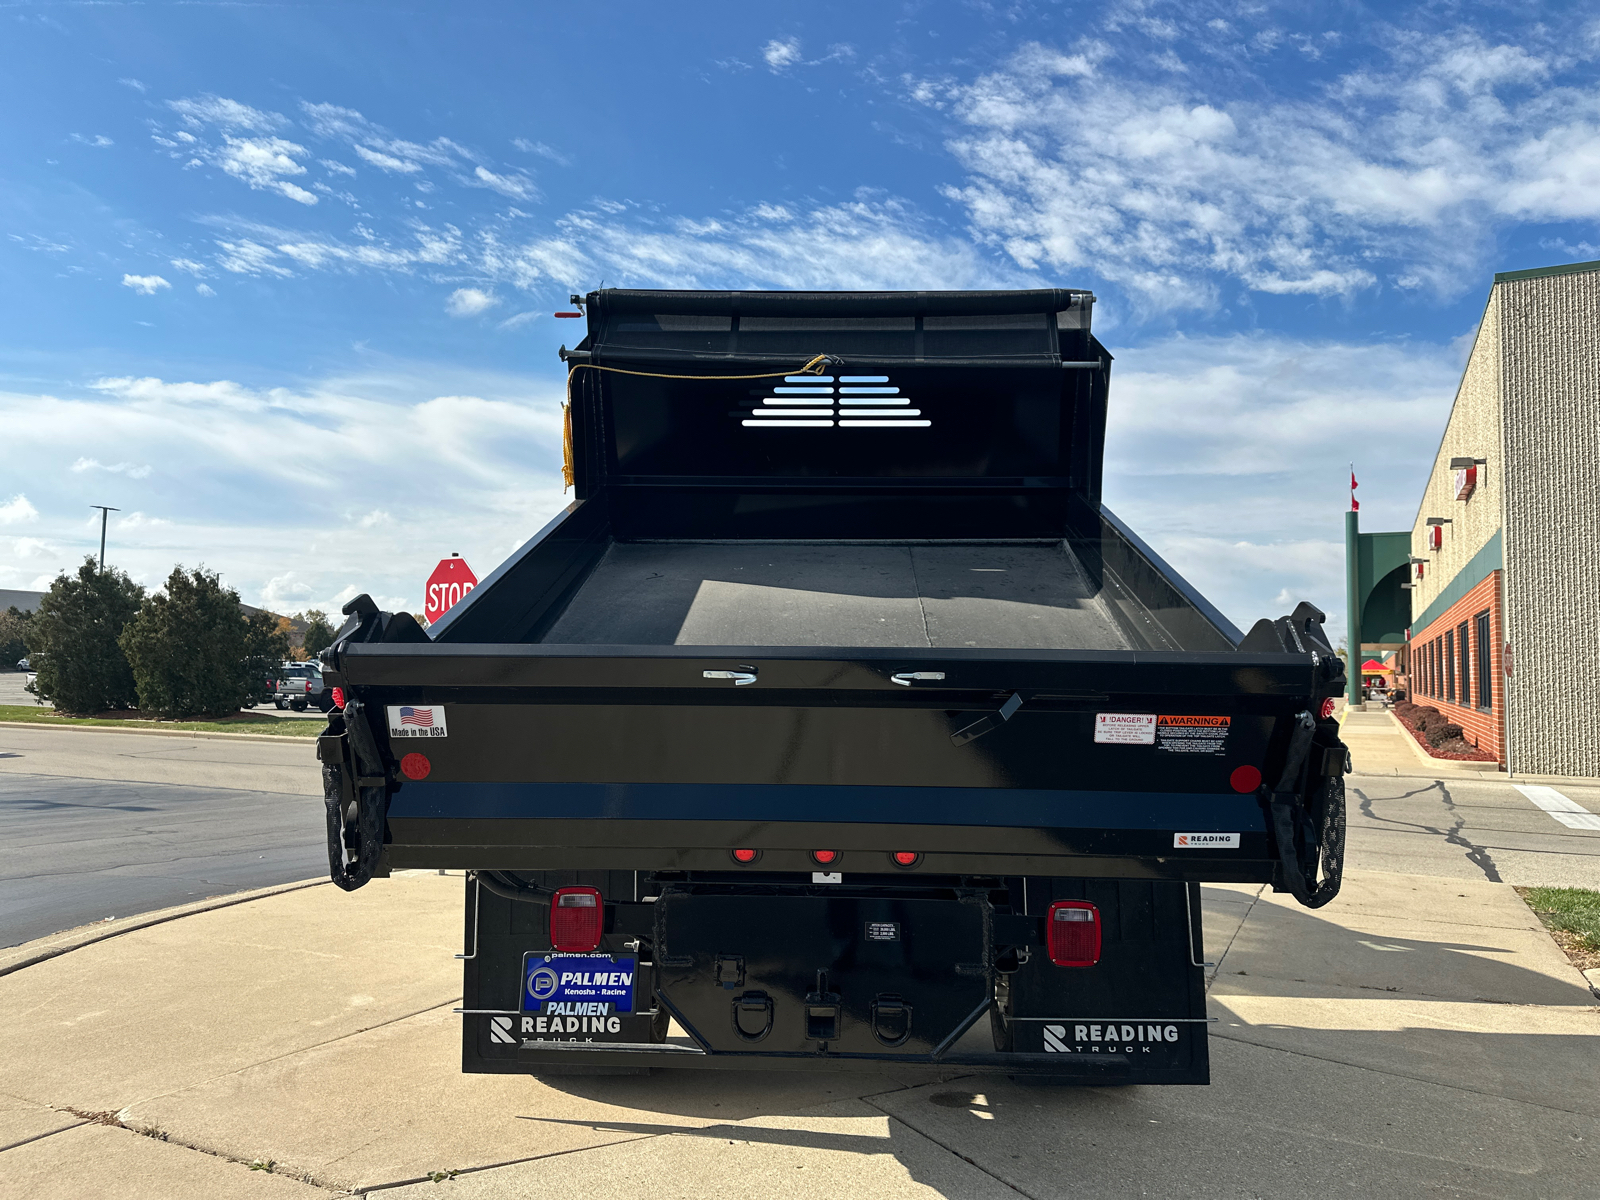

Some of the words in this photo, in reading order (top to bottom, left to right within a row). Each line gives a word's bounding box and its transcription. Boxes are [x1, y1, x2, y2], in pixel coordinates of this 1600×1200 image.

[411, 728, 417, 736] in
[430, 727, 445, 736] USA
[560, 972, 633, 986] PALMEN
[547, 1002, 609, 1016] PALMEN
[521, 1017, 620, 1033] READING
[1075, 1025, 1178, 1042] READING
